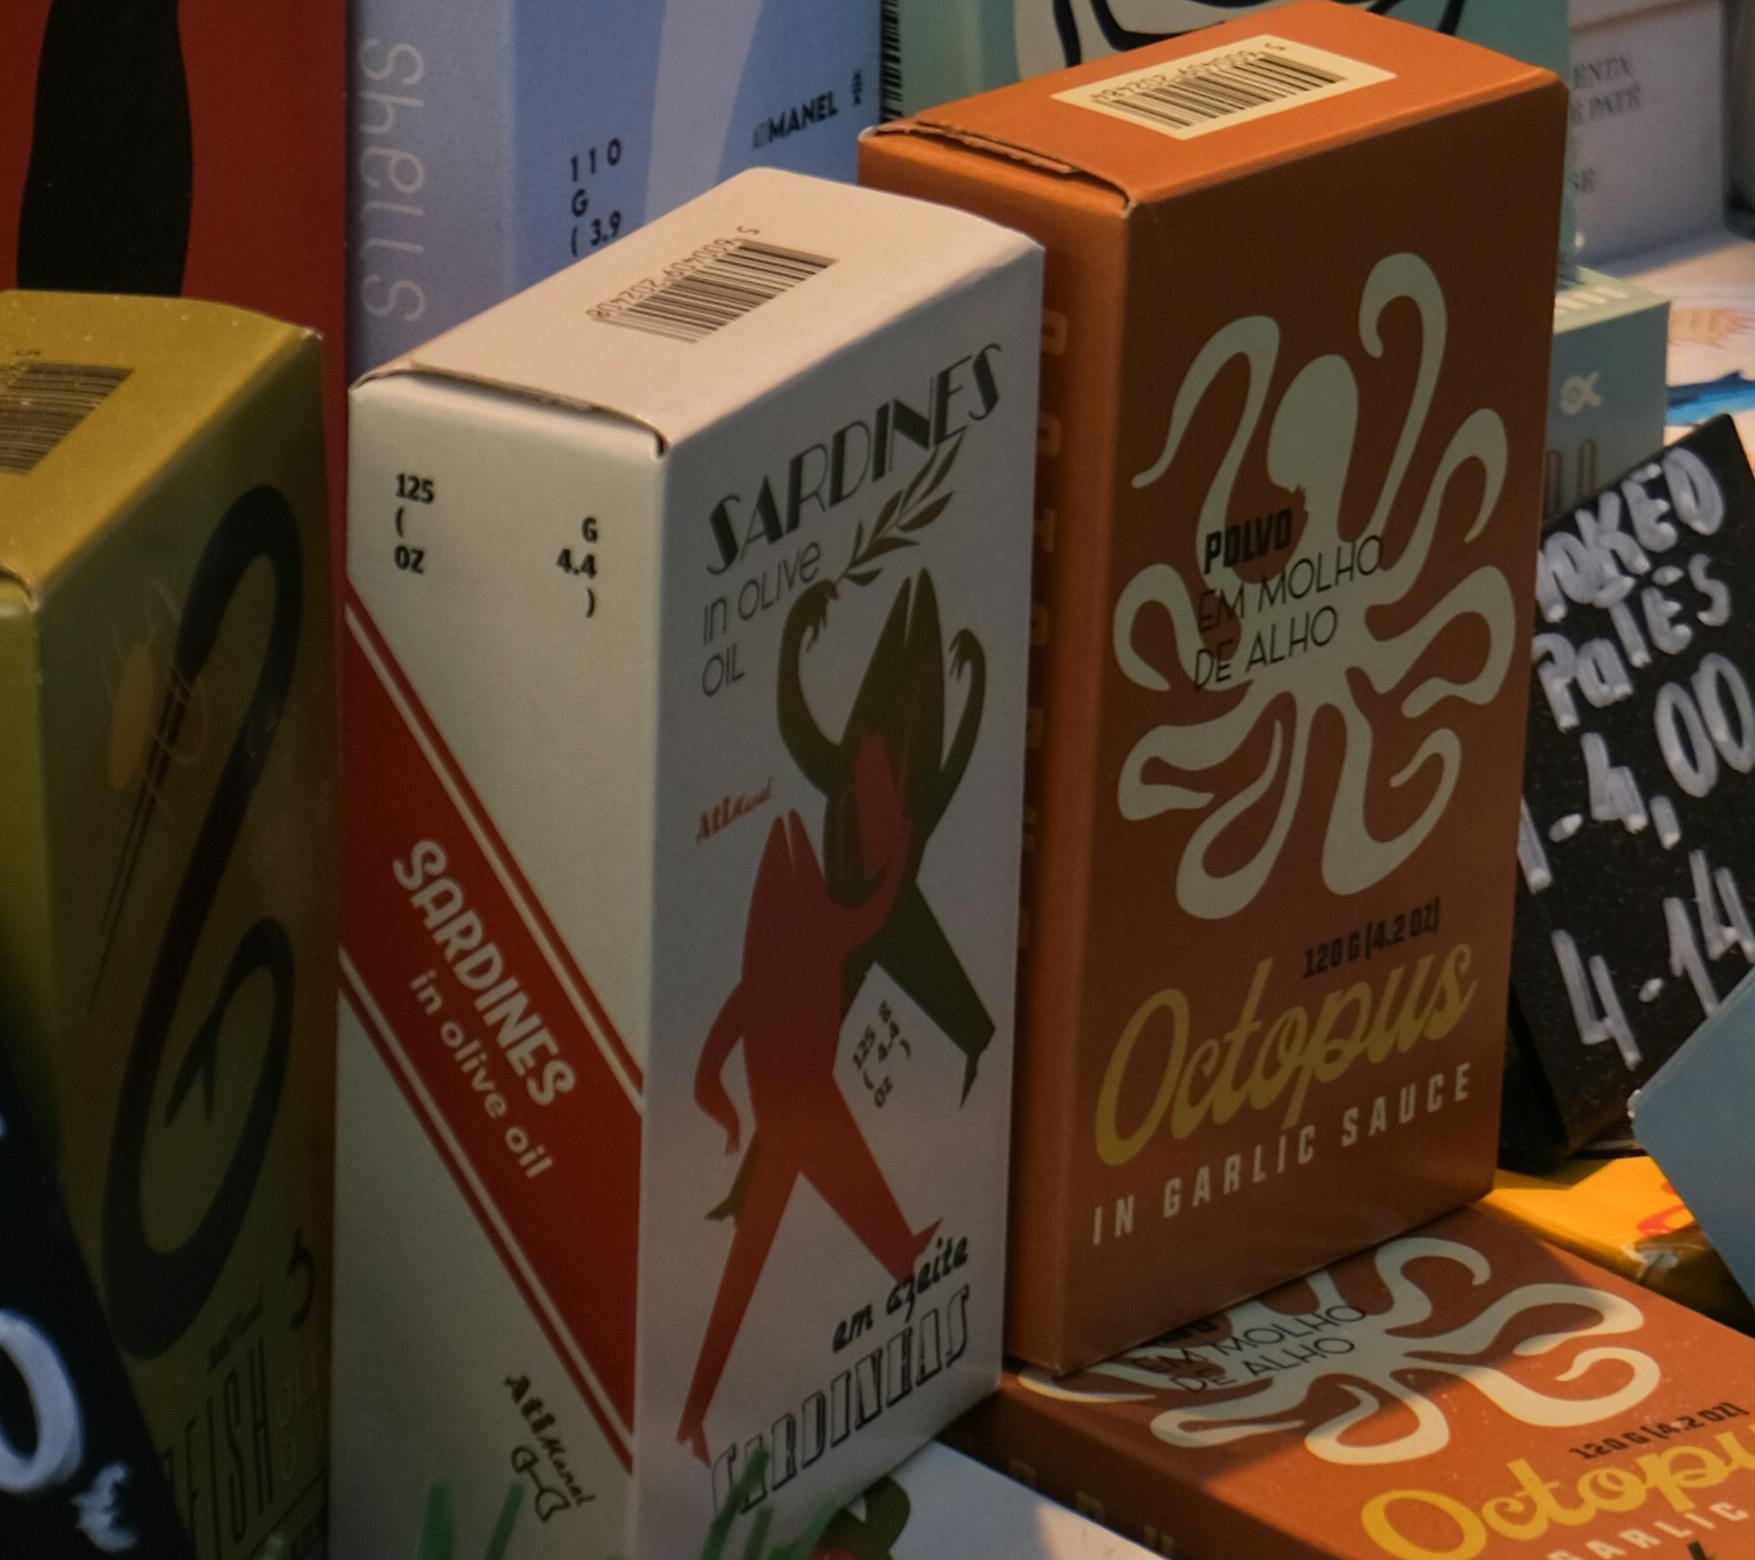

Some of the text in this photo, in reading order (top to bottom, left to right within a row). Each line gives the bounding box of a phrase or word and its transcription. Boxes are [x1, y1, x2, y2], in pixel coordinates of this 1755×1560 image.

[766, 90, 839, 144] MANEL
[570, 137, 623, 183] 110
[570, 188, 590, 218] G
[703, 342, 1004, 578] SARDINES
[394, 472, 599, 544] 125 G
[394, 544, 426, 576] OZ
[556, 547, 598, 581] 4.4
[1204, 507, 1293, 575] POLVO
[1198, 534, 1384, 633] EM MOLHO
[700, 643, 746, 699] OIL
[1194, 605, 1338, 690] DE ALHO
[391, 838, 577, 1107] SARDINES
[1303, 937, 1343, 979] 120
[408, 969, 556, 1181] in olive oil
[1094, 941, 1480, 1167] Octopus
[1092, 1060, 1472, 1247] IN GARLIC SAUCE
[1209, 1304, 1367, 1356] MOLHO
[1170, 1337, 1355, 1394] DE ALHO
[710, 1283, 972, 1522] SARDINHAS
[1569, 1439, 1624, 1462] 120
